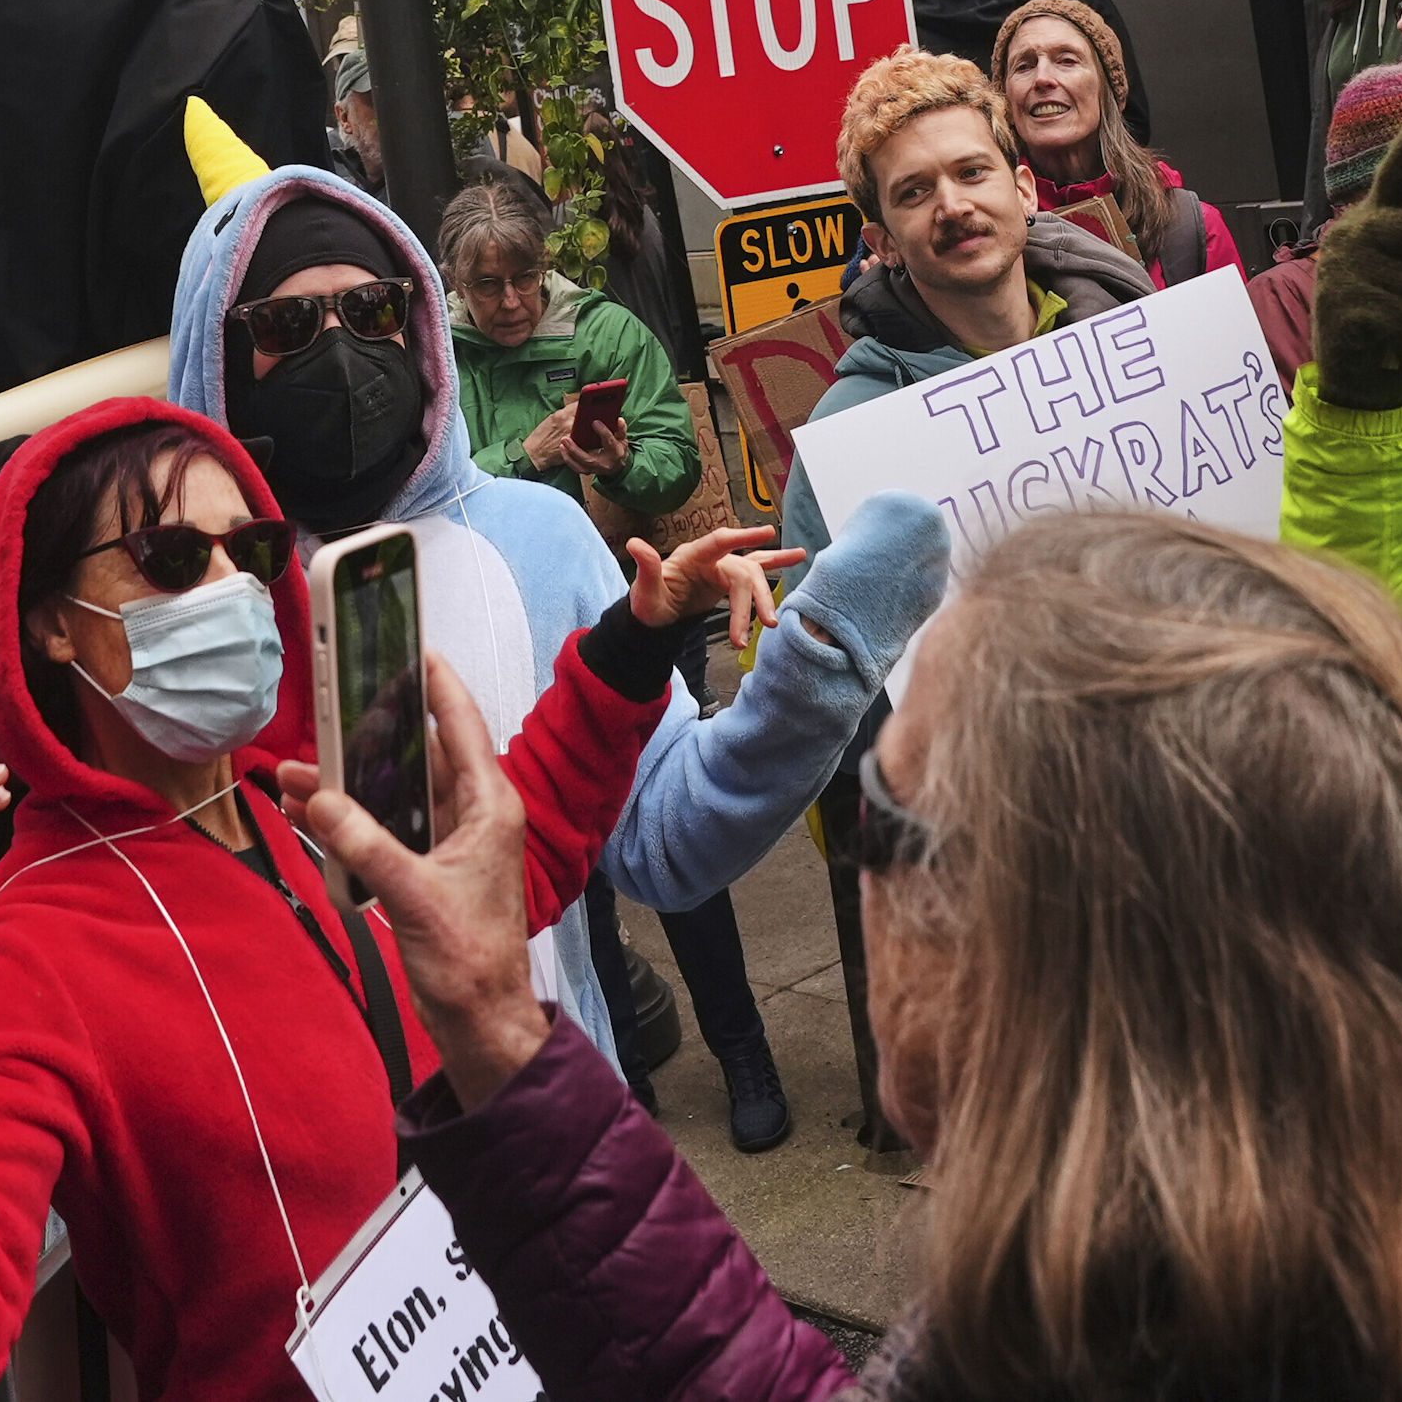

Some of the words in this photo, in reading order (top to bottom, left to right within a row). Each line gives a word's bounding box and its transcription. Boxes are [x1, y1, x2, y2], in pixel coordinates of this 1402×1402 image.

[741, 213, 845, 274] SLOW
[923, 305, 1165, 454] THE
[937, 351, 1284, 573] UCKRAT'S
[352, 1286, 447, 1394] Elon,
[429, 1315, 520, 1402] ying
